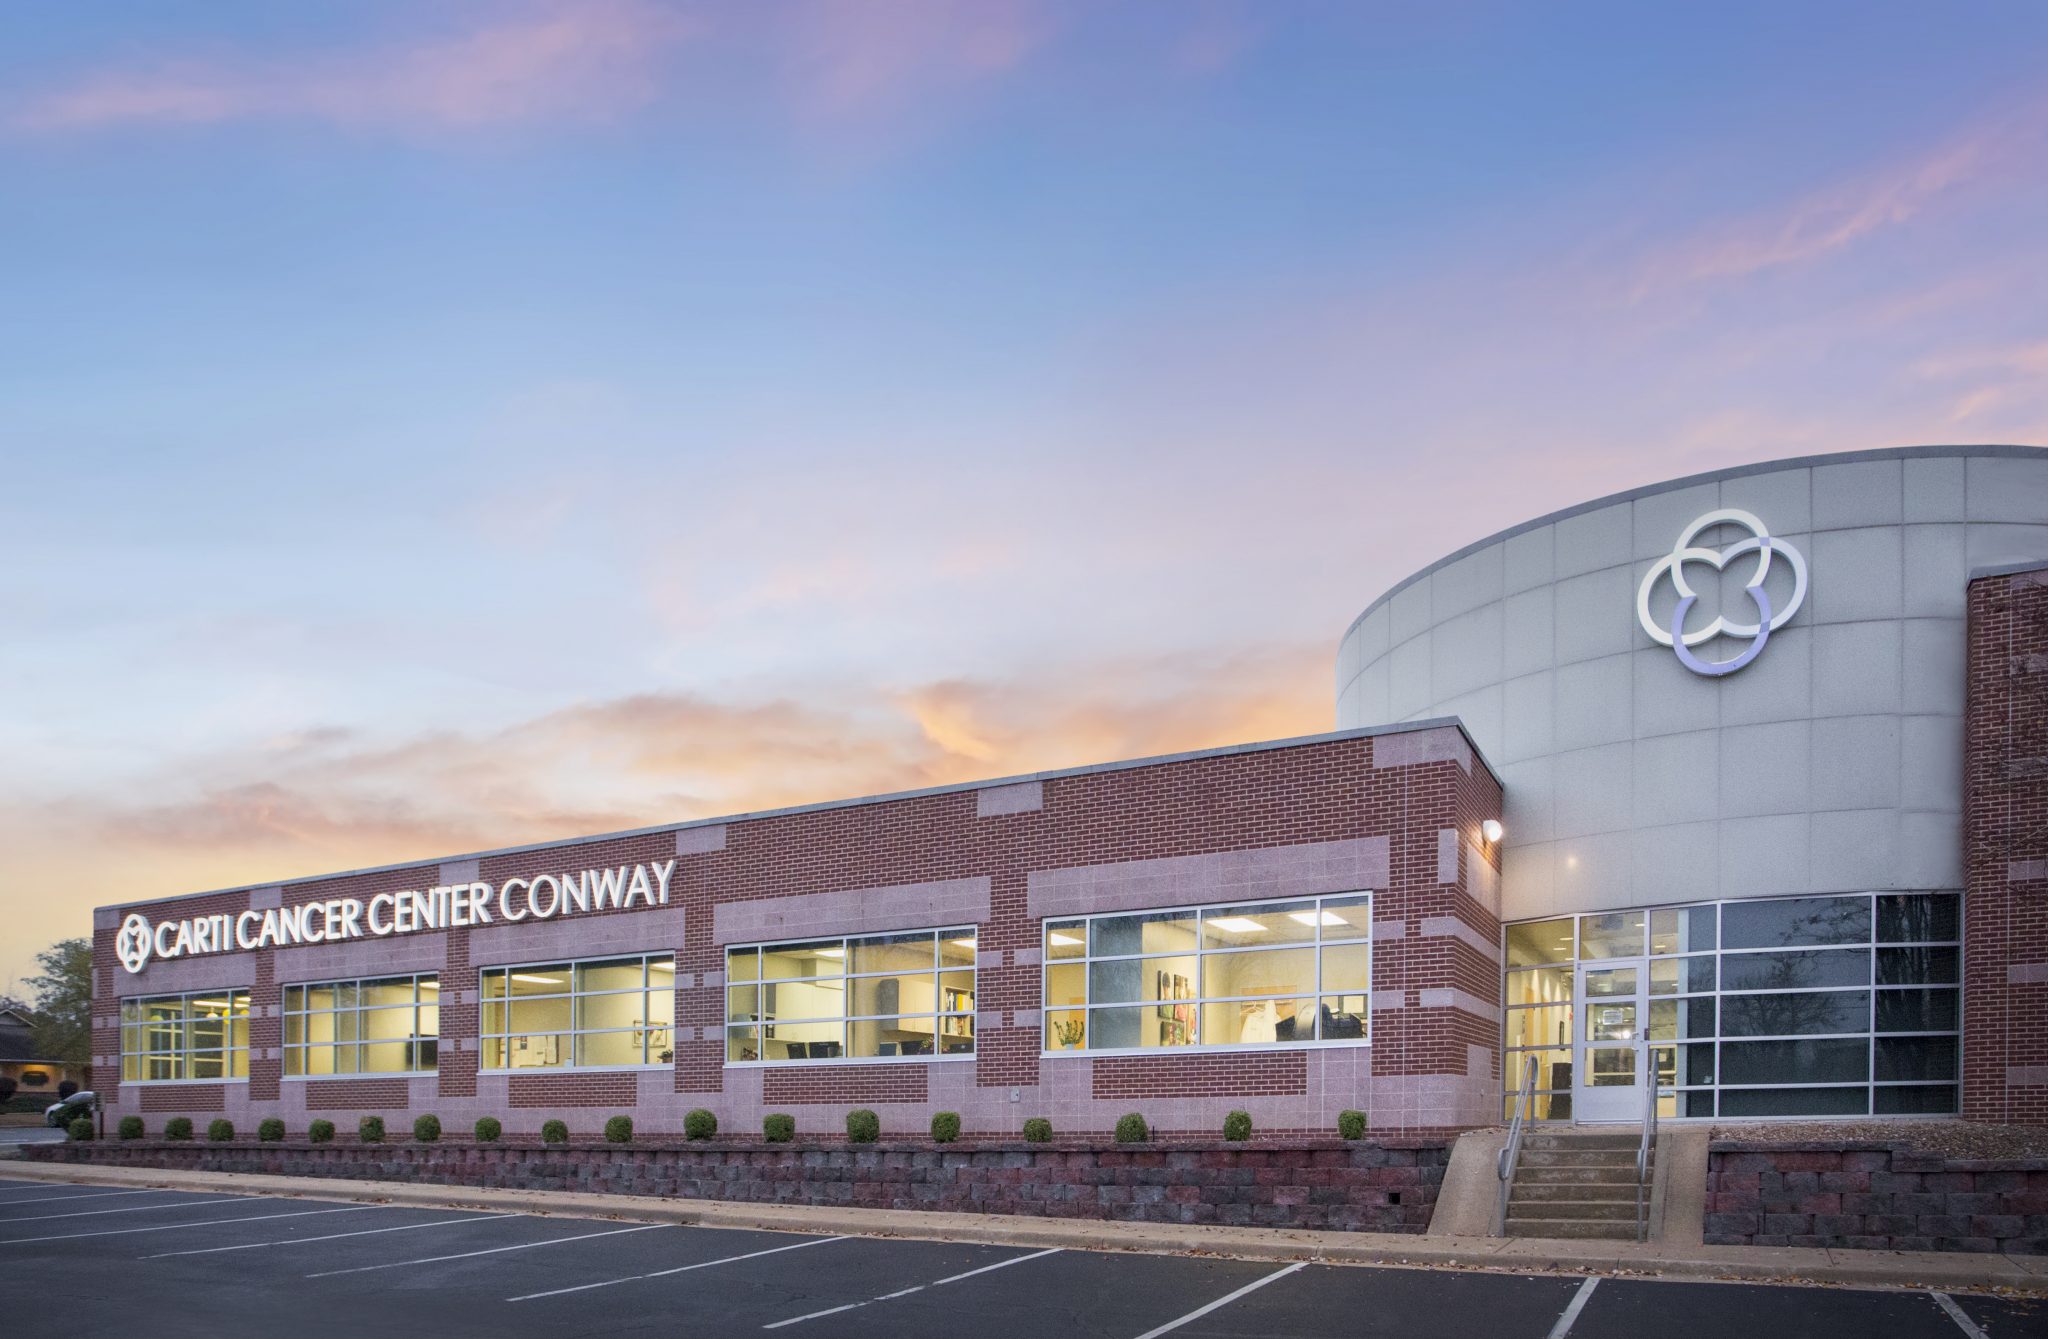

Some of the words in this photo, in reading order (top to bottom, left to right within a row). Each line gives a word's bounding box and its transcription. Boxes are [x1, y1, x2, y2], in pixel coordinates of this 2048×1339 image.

[154, 915, 233, 959] CARTI
[236, 898, 363, 950] CANCER
[368, 881, 494, 935] CENTER
[500, 860, 676, 921] CONWAY
